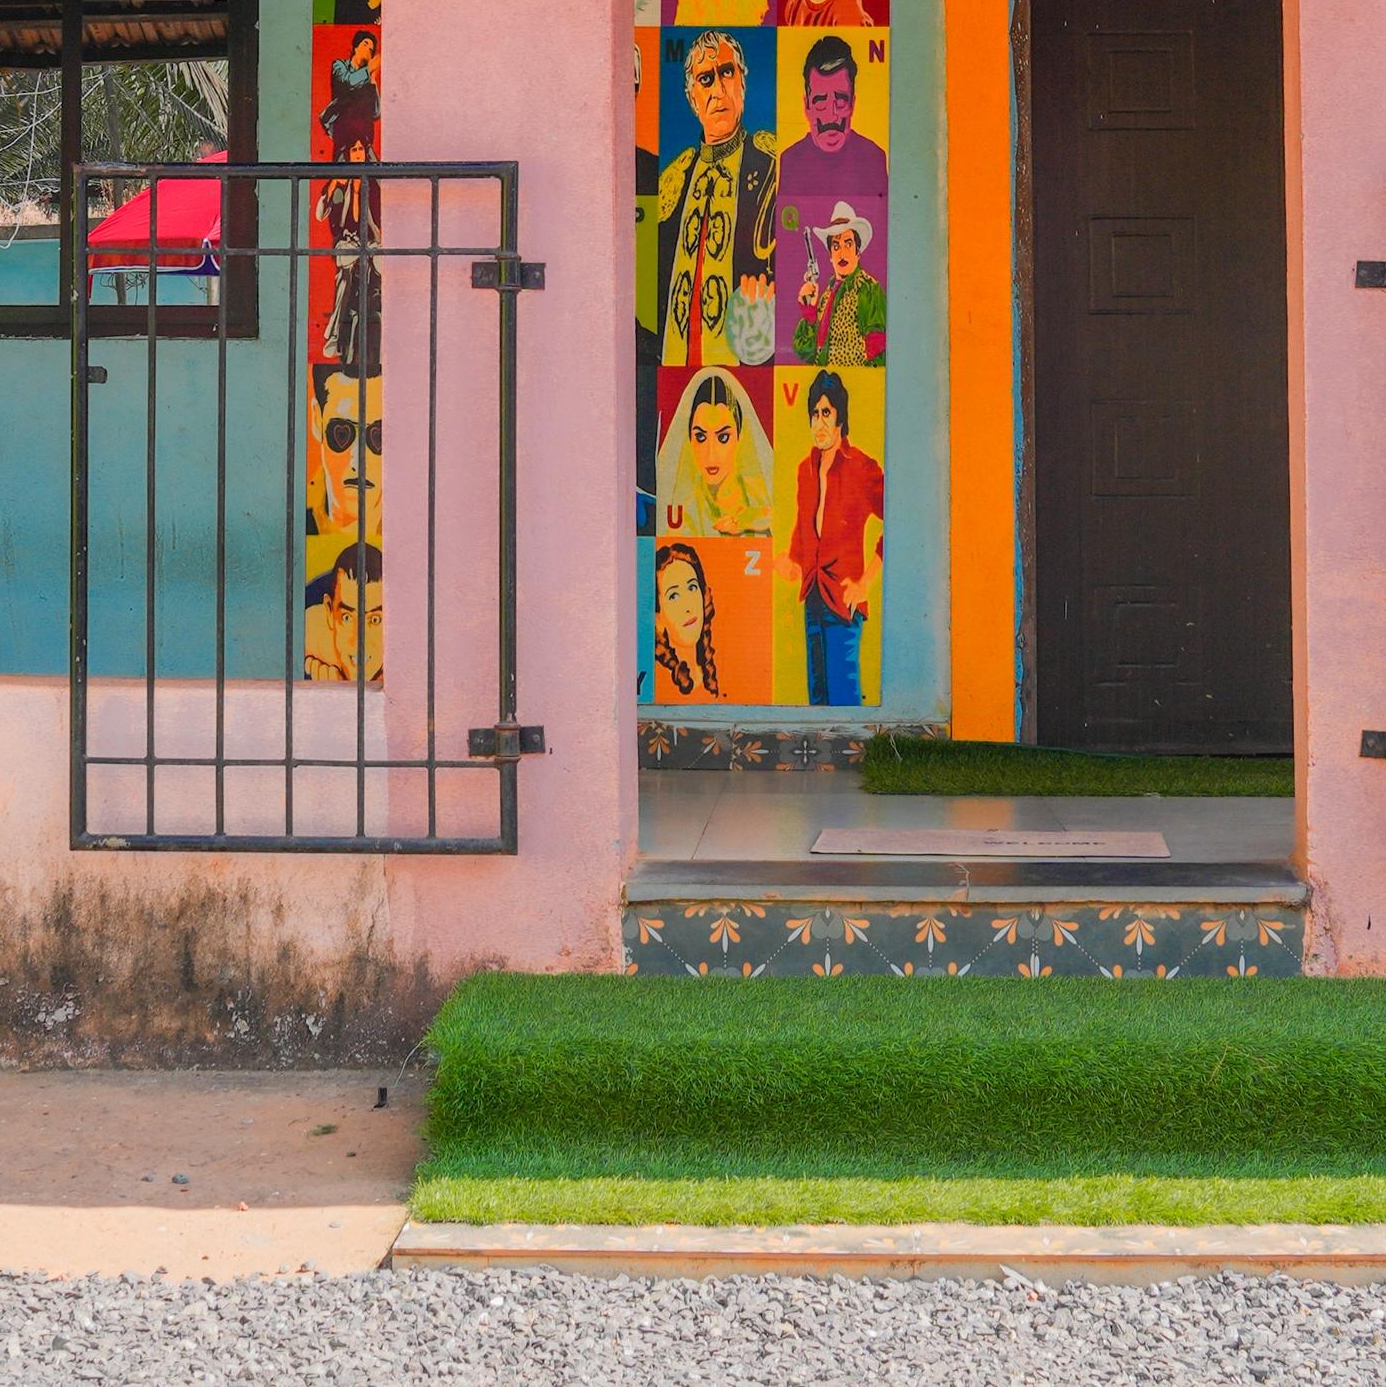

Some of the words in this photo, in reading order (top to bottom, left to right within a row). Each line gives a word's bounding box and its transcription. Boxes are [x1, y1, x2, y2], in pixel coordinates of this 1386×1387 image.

[666, 39, 684, 62] M
[869, 40, 885, 63] N
[781, 205, 799, 231] Q
[783, 383, 799, 406] V
[667, 505, 683, 529] U
[744, 550, 761, 576] Z
